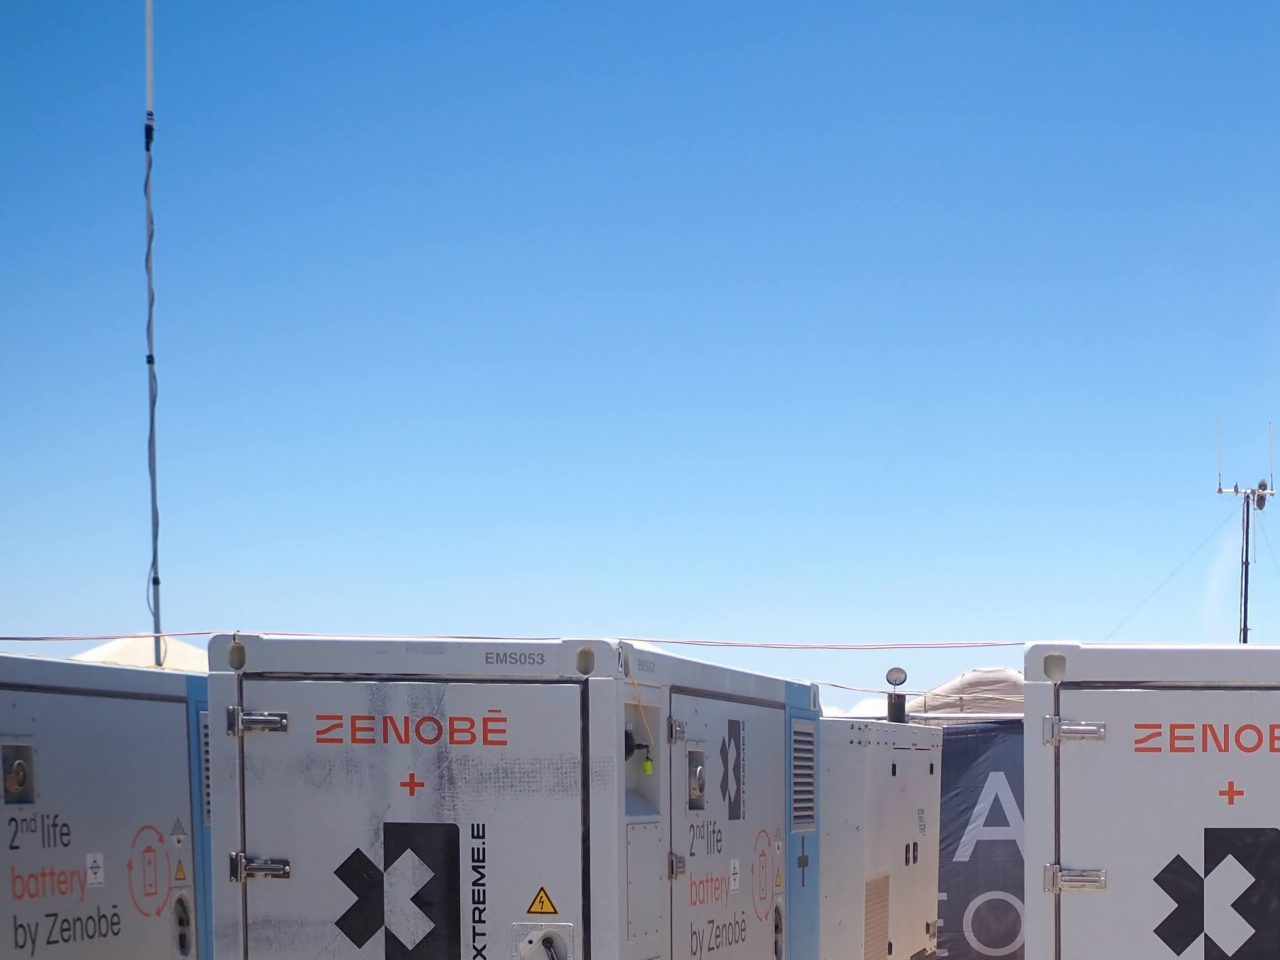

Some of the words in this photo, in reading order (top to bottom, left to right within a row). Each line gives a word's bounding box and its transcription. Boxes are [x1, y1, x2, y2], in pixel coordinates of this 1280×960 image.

[485, 652, 545, 665] EMS053
[315, 709, 508, 746] ZENOBĒ
[41, 814, 71, 848] life
[706, 820, 722, 855] life
[10, 865, 88, 904] battery
[689, 872, 730, 909] battery
[13, 914, 39, 957] by
[45, 905, 121, 945] Zenobē
